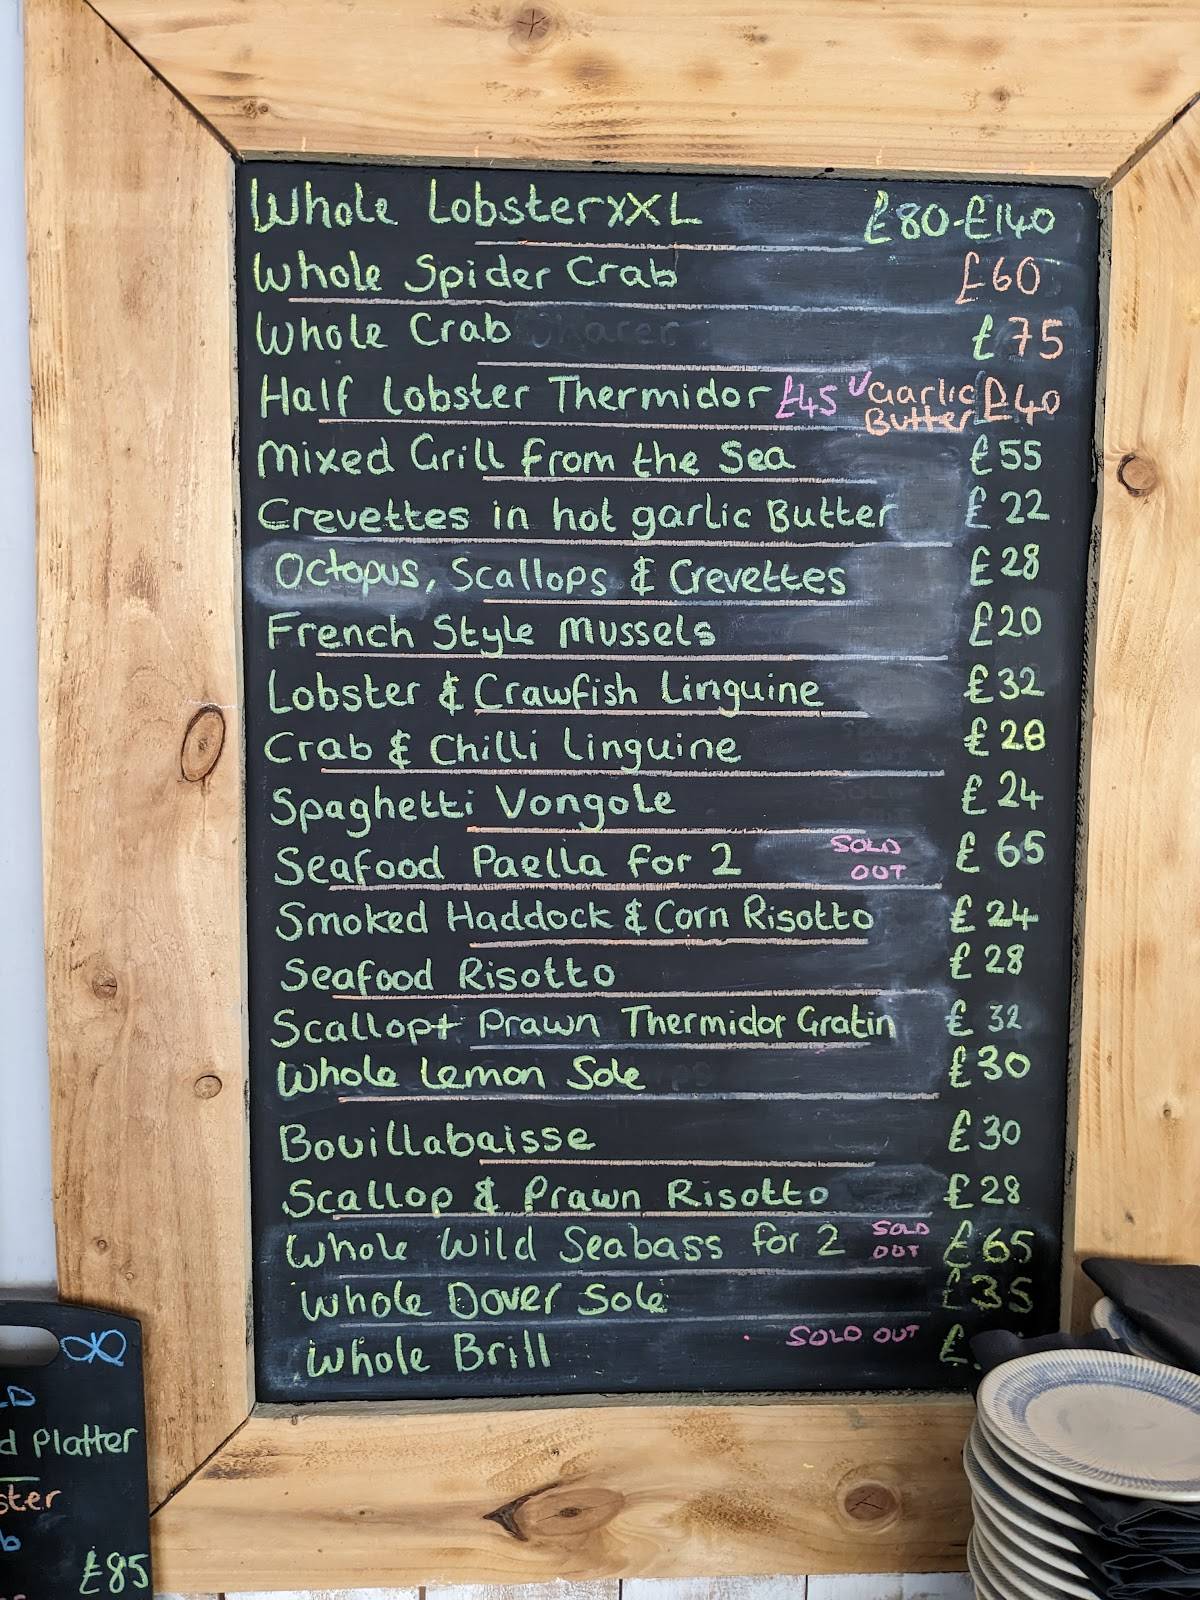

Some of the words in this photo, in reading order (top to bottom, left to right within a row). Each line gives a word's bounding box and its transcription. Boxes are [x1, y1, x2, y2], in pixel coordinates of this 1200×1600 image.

[251, 178, 398, 233] Whole
[252, 250, 383, 292] Whole
[405, 254, 551, 298] Spider
[566, 255, 677, 289] Crab
[955, 251, 1041, 305] £60
[256, 312, 388, 356] Whole
[409, 312, 511, 346] Crab
[260, 374, 353, 418] Half
[548, 375, 773, 413] Thermidor
[776, 375, 838, 419] £45
[867, 378, 976, 405] Garlic
[983, 376, 1061, 425] £40
[865, 405, 976, 436] Butter
[257, 437, 395, 480] Mixed
[411, 433, 505, 471] Grill
[633, 440, 700, 478] the
[719, 440, 797, 475] Sea
[970, 434, 1043, 477] £55
[257, 498, 470, 534] Crevettes
[493, 500, 529, 531] in
[552, 497, 617, 533] hot
[631, 493, 751, 541] garlic
[767, 496, 900, 533] Butter
[275, 548, 436, 595] Octopus,
[451, 557, 608, 597] Scallops
[630, 555, 656, 596] &
[669, 558, 847, 596] Crevettes
[267, 610, 415, 650] French
[432, 613, 535, 657] Style
[968, 600, 1042, 647] £20
[267, 669, 421, 715] Lobster
[438, 670, 464, 716] &
[474, 671, 638, 711] Crawfish
[264, 731, 373, 764] Crab
[389, 729, 411, 770] &
[430, 729, 538, 767] Chilli
[269, 785, 475, 839] Spaghetti
[495, 783, 676, 832] Vongole
[274, 845, 445, 886] Seafood
[472, 844, 608, 880] Paella
[711, 842, 742, 876] 2
[830, 835, 901, 855] SOLD
[850, 864, 907, 880] OUT
[275, 900, 429, 942] Smoked
[447, 899, 614, 933] Haddock
[624, 898, 648, 936] &
[655, 900, 729, 935] Corn
[743, 893, 875, 933] Risotto
[280, 957, 434, 995] Seafood
[458, 957, 616, 989] Risotto
[478, 1009, 601, 1039] Prawn
[621, 1004, 786, 1038] Thermidor
[797, 1004, 896, 1039] Gratin
[277, 1055, 400, 1100] Whole
[566, 1055, 646, 1091] Sole
[278, 1119, 597, 1163] Bouillabaisse
[281, 1179, 454, 1219] Scallop
[473, 1176, 499, 1215] &
[524, 1175, 642, 1214] Prawn
[668, 1177, 830, 1208] Risotto
[286, 1232, 408, 1269] Whole
[437, 1226, 536, 1262] Wild
[559, 1224, 723, 1264] Seabass
[752, 1221, 800, 1256] for
[816, 1224, 846, 1257] 2
[872, 1220, 930, 1236] SOLD
[873, 1244, 920, 1258] OUT
[300, 1280, 433, 1322] Whole
[447, 1280, 563, 1321] Dover
[577, 1280, 669, 1316] Sole
[305, 1335, 431, 1379] Whole
[454, 1330, 551, 1373] Brill
[785, 1326, 862, 1346] SOLD
[873, 1325, 920, 1343] OUT
[33, 1424, 138, 1458] Platter
[79, 1549, 149, 1594] £85
